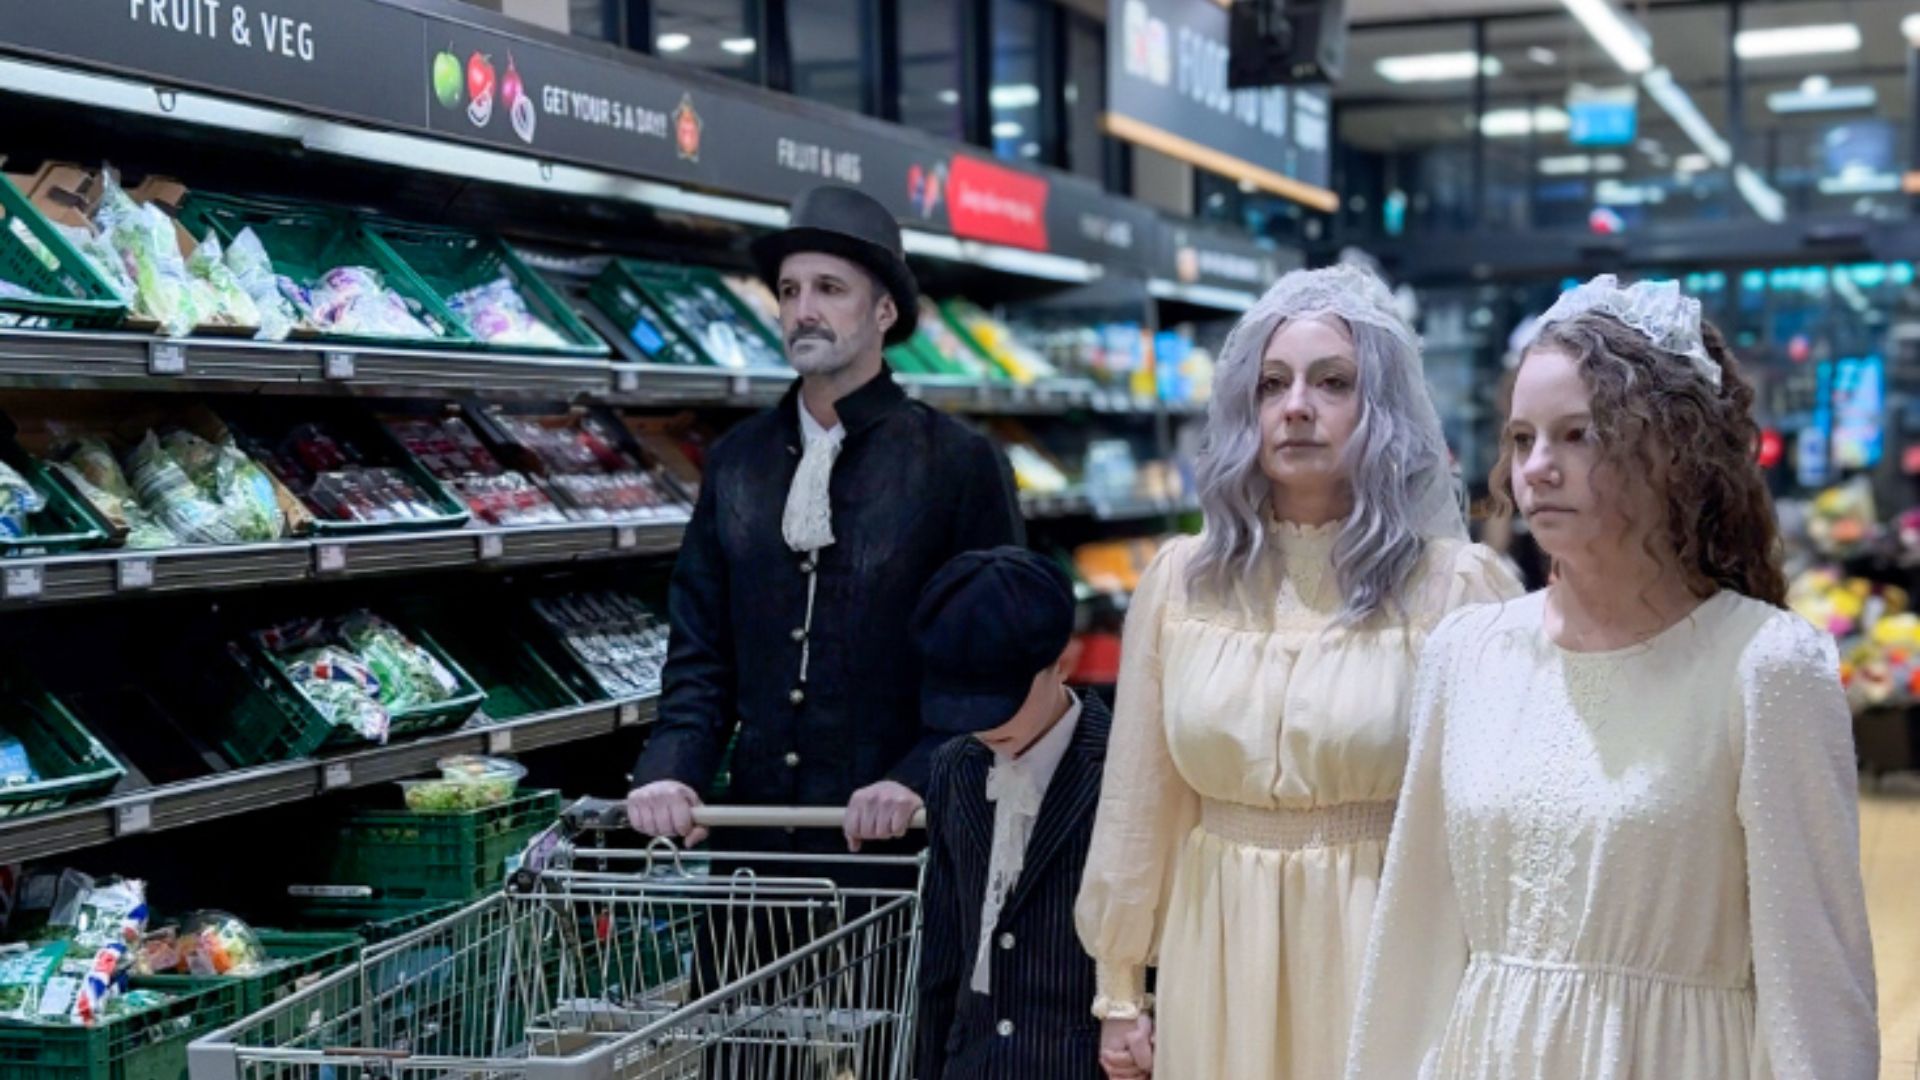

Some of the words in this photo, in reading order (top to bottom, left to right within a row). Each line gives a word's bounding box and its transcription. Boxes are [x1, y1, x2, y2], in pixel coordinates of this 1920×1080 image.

[232, 5, 252, 47] &
[261, 12, 315, 61] VEG
[543, 84, 569, 116] GET
[572, 91, 610, 125] YOUR
[611, 102, 622, 128] 5
[624, 104, 635, 130] A
